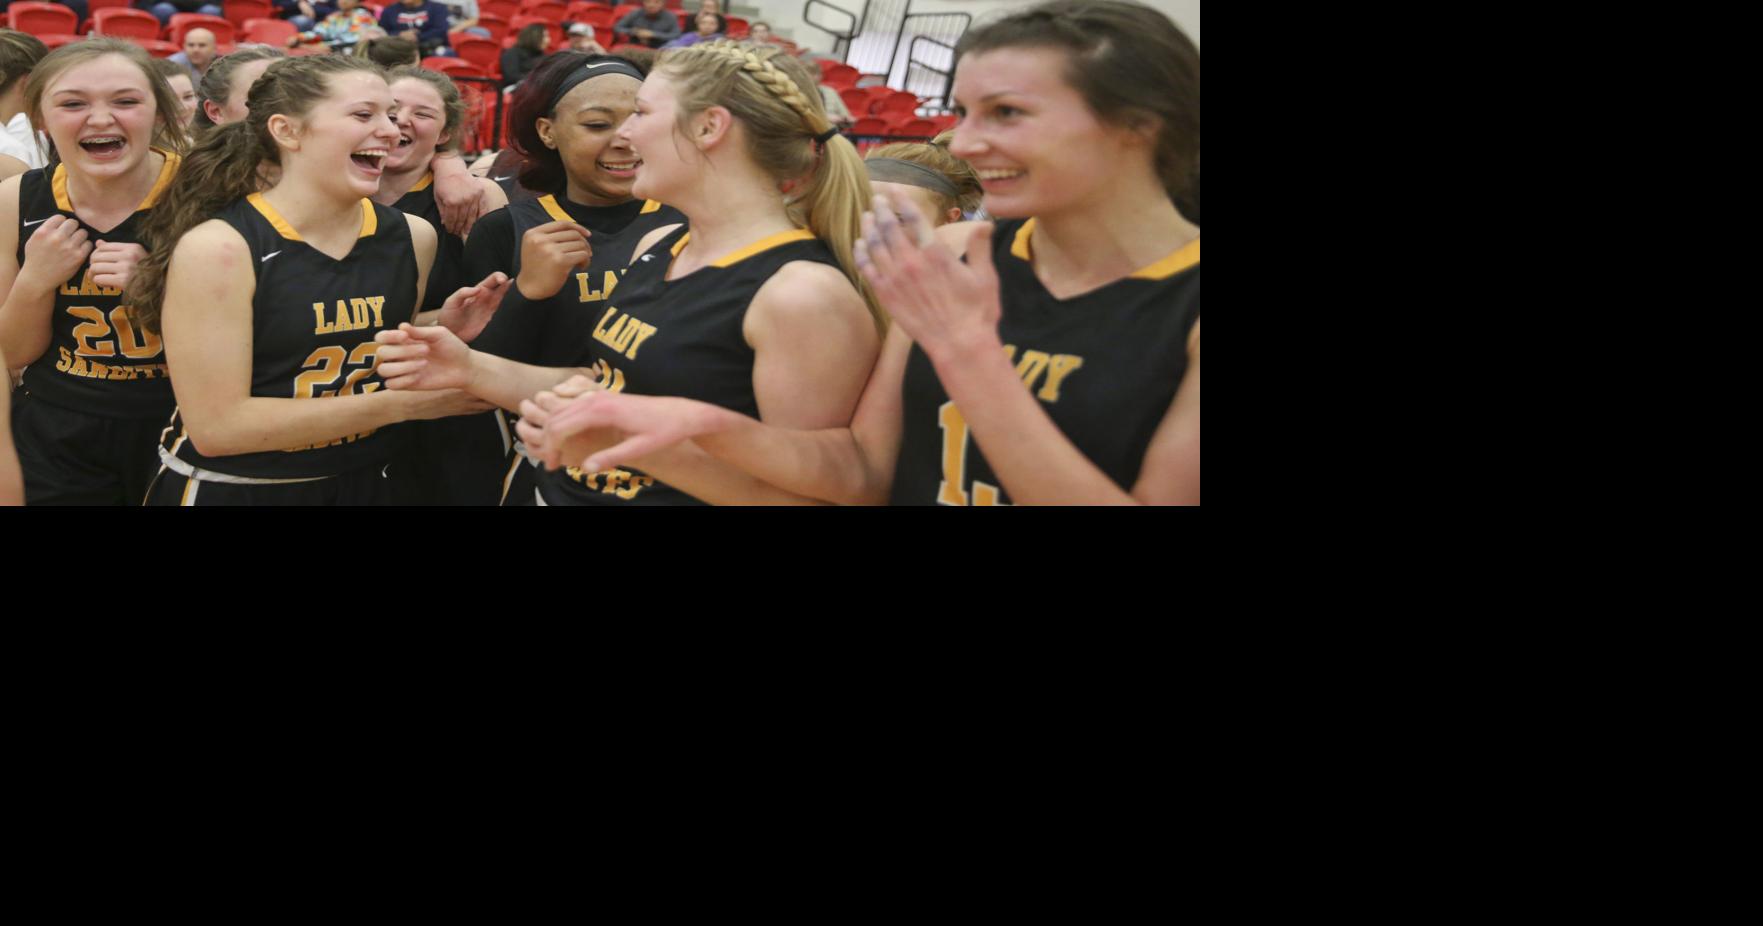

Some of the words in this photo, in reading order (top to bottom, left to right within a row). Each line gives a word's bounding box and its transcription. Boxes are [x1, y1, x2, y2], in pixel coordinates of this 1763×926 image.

[66, 305, 163, 358] 20
[313, 296, 385, 335] LADY
[592, 306, 658, 360] LADY
[293, 341, 384, 400] 22
